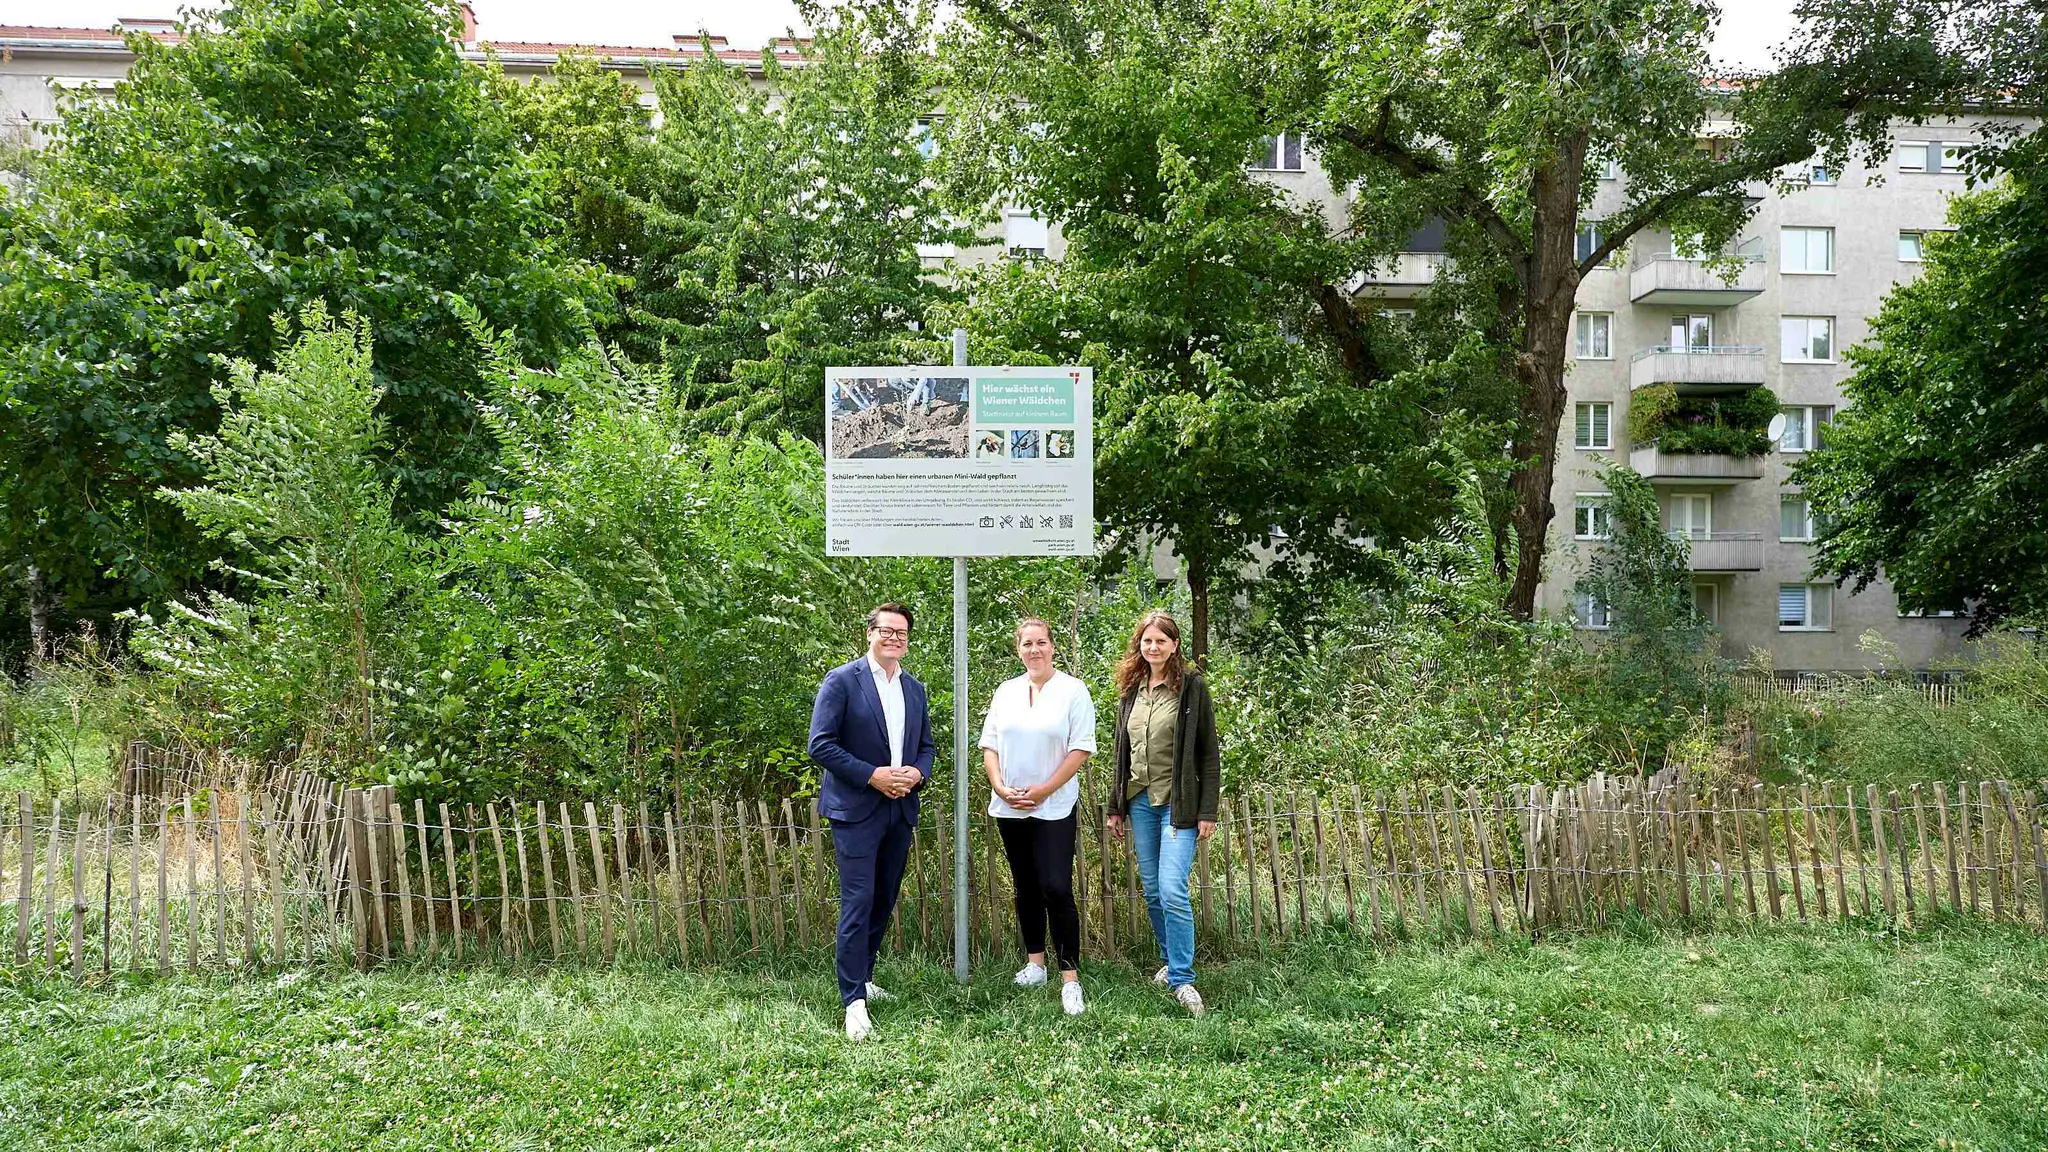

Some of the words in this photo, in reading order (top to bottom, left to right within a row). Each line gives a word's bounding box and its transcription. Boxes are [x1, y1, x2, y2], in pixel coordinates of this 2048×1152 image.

[983, 384, 1003, 393] Hier
[1005, 384, 1038, 393] wächst
[1040, 384, 1055, 393] ein
[983, 396, 1017, 405] Wiener
[1019, 396, 1067, 405] Wäldchen
[987, 473, 1017, 481] gepflanzt
